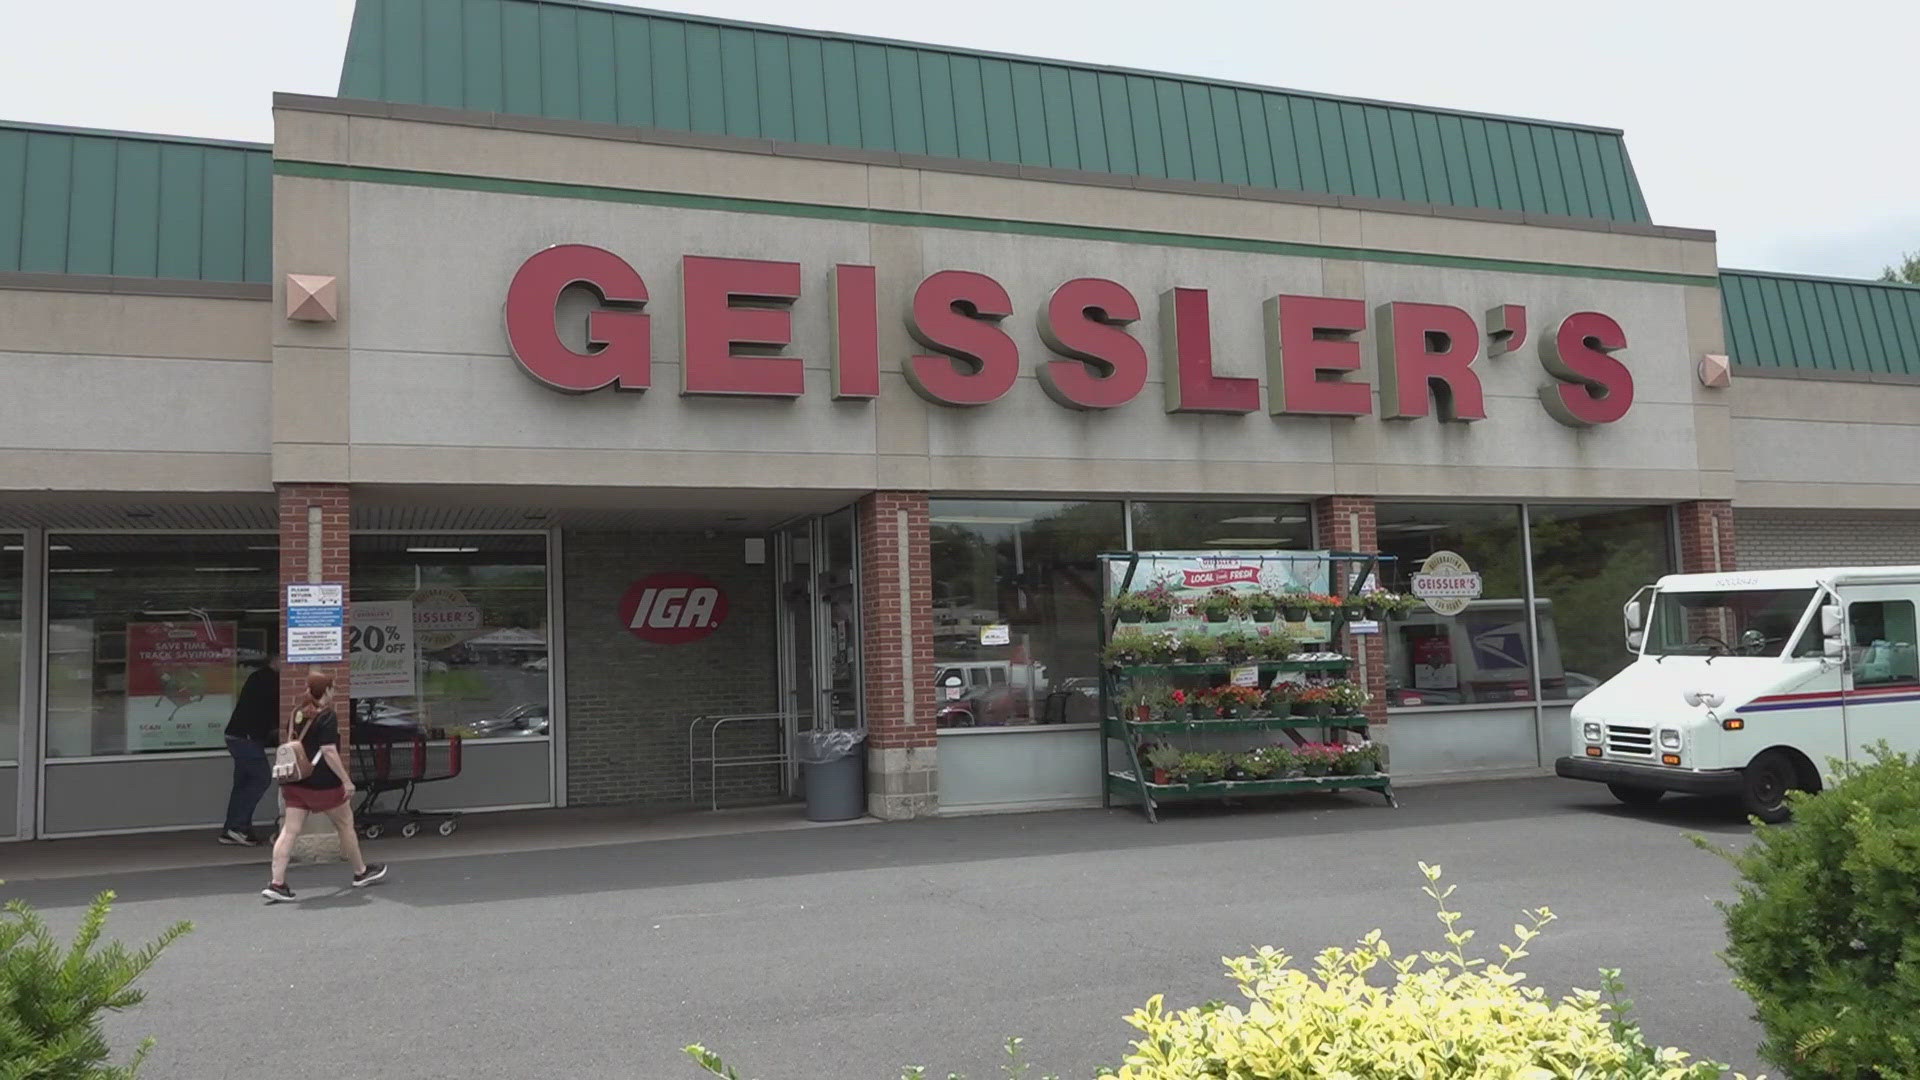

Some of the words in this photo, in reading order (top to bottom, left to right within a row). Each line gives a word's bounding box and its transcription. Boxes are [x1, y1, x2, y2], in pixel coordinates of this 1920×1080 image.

[504, 243, 1635, 425] GEISSLER'S
[1190, 573, 1214, 584] LOCAL
[1229, 570, 1253, 580] FRESH
[1418, 578, 1476, 590] GEISSLER'S
[412, 611, 475, 623] EISSLER'S
[155, 642, 181, 651] SAVE
[385, 643, 405, 654] OFF
[139, 652, 171, 661] TRACK
